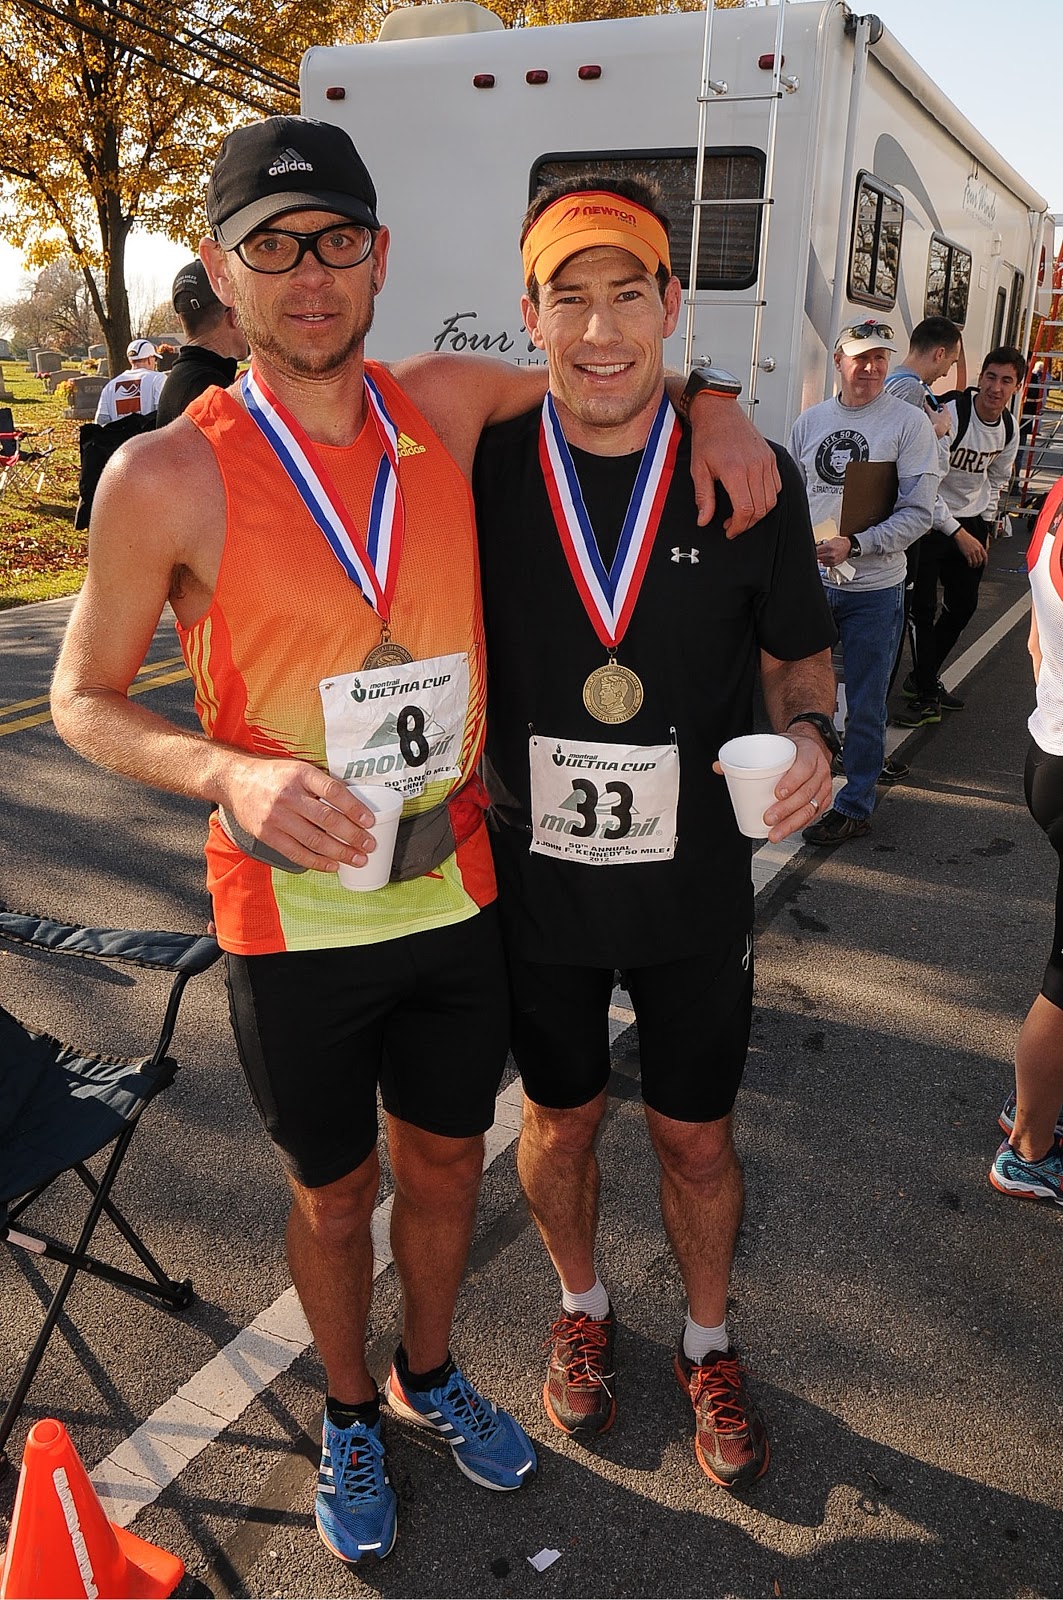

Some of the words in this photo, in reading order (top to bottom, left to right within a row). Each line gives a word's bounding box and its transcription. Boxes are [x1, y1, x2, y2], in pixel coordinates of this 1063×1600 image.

[268, 160, 314, 176] adidas
[583, 206, 637, 224] NEWTON
[434, 311, 515, 352] Four
[822, 433, 838, 450] JFK
[840, 430, 851, 438] 50
[852, 432, 868, 451] MILE
[368, 681, 420, 700] ULTRA
[422, 674, 451, 689] CUP
[370, 679, 400, 689] montrail
[397, 705, 430, 767] 8
[565, 758, 619, 771] ULTRA
[621, 762, 656, 771] CUP
[571, 778, 634, 840] 33
[540, 841, 561, 851] JOHN
[575, 848, 622, 858] KENNEDY
[624, 848, 638, 856] 50
[640, 847, 664, 855] MILE
[590, 844, 632, 853] ANNUAL
